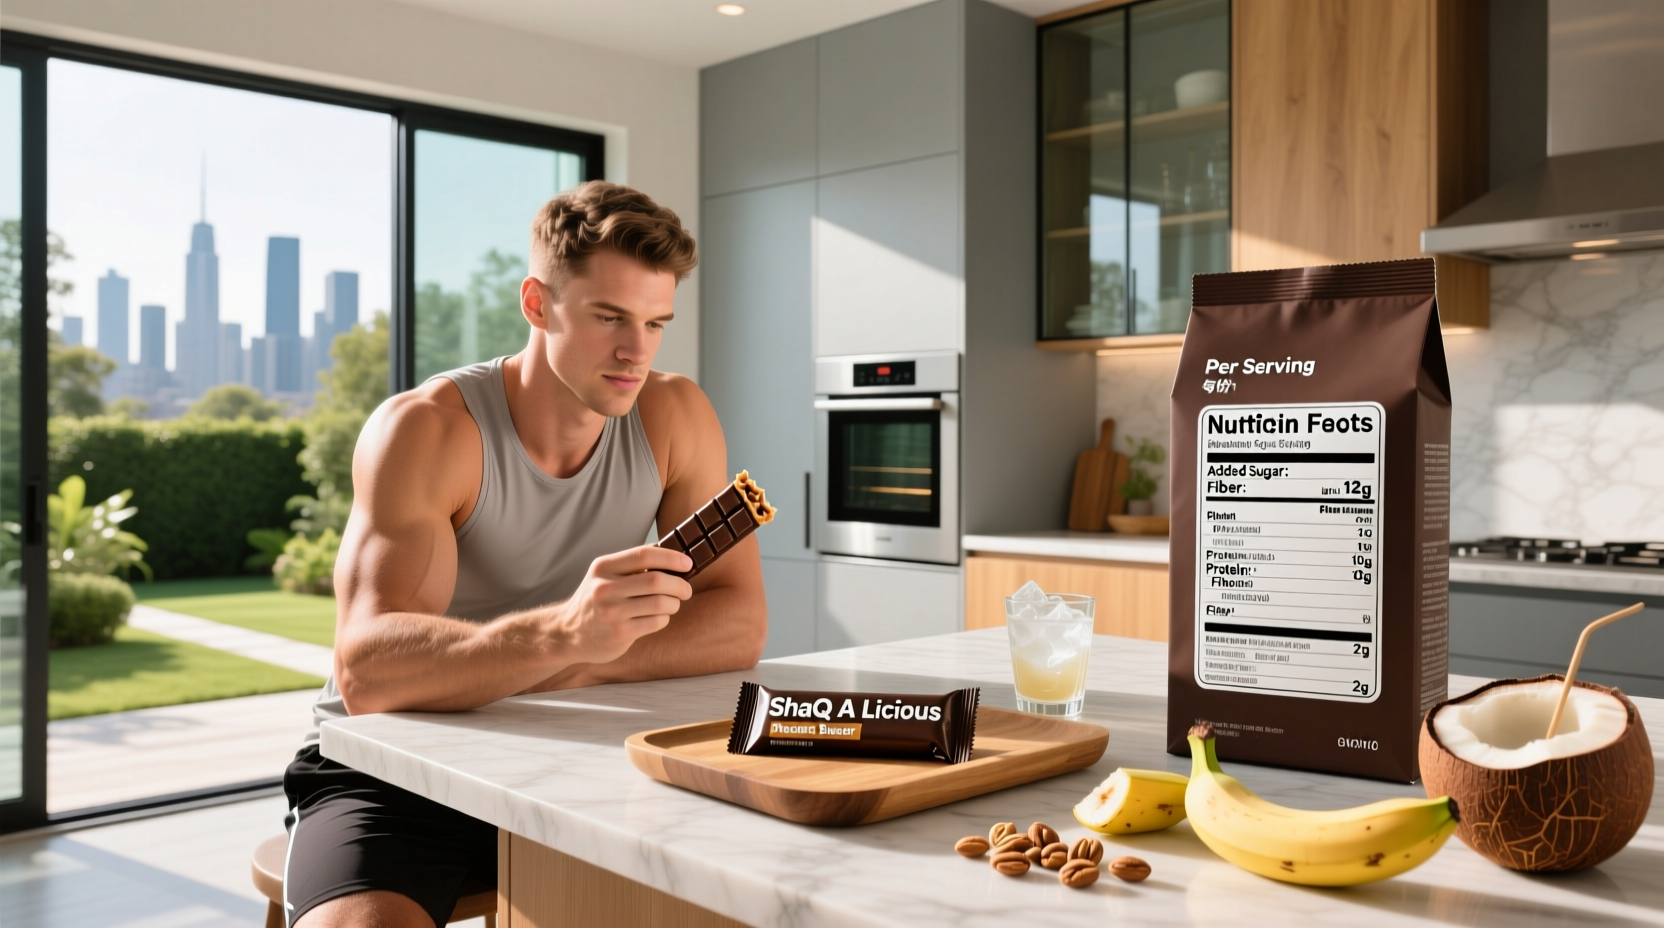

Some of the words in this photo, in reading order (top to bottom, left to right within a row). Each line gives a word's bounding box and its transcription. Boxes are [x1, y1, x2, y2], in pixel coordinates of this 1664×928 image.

[1205, 359, 1239, 375] Per
[1242, 357, 1316, 377] Serving
[1207, 464, 1247, 477] Added
[1249, 465, 1289, 481] Sugar:
[1344, 480, 1372, 499] 12g
[1353, 643, 1370, 659] 2g
[1352, 680, 1370, 695] 2g
[768, 696, 834, 721] ShaQ
[836, 698, 856, 719] A
[861, 698, 942, 722] Licious
